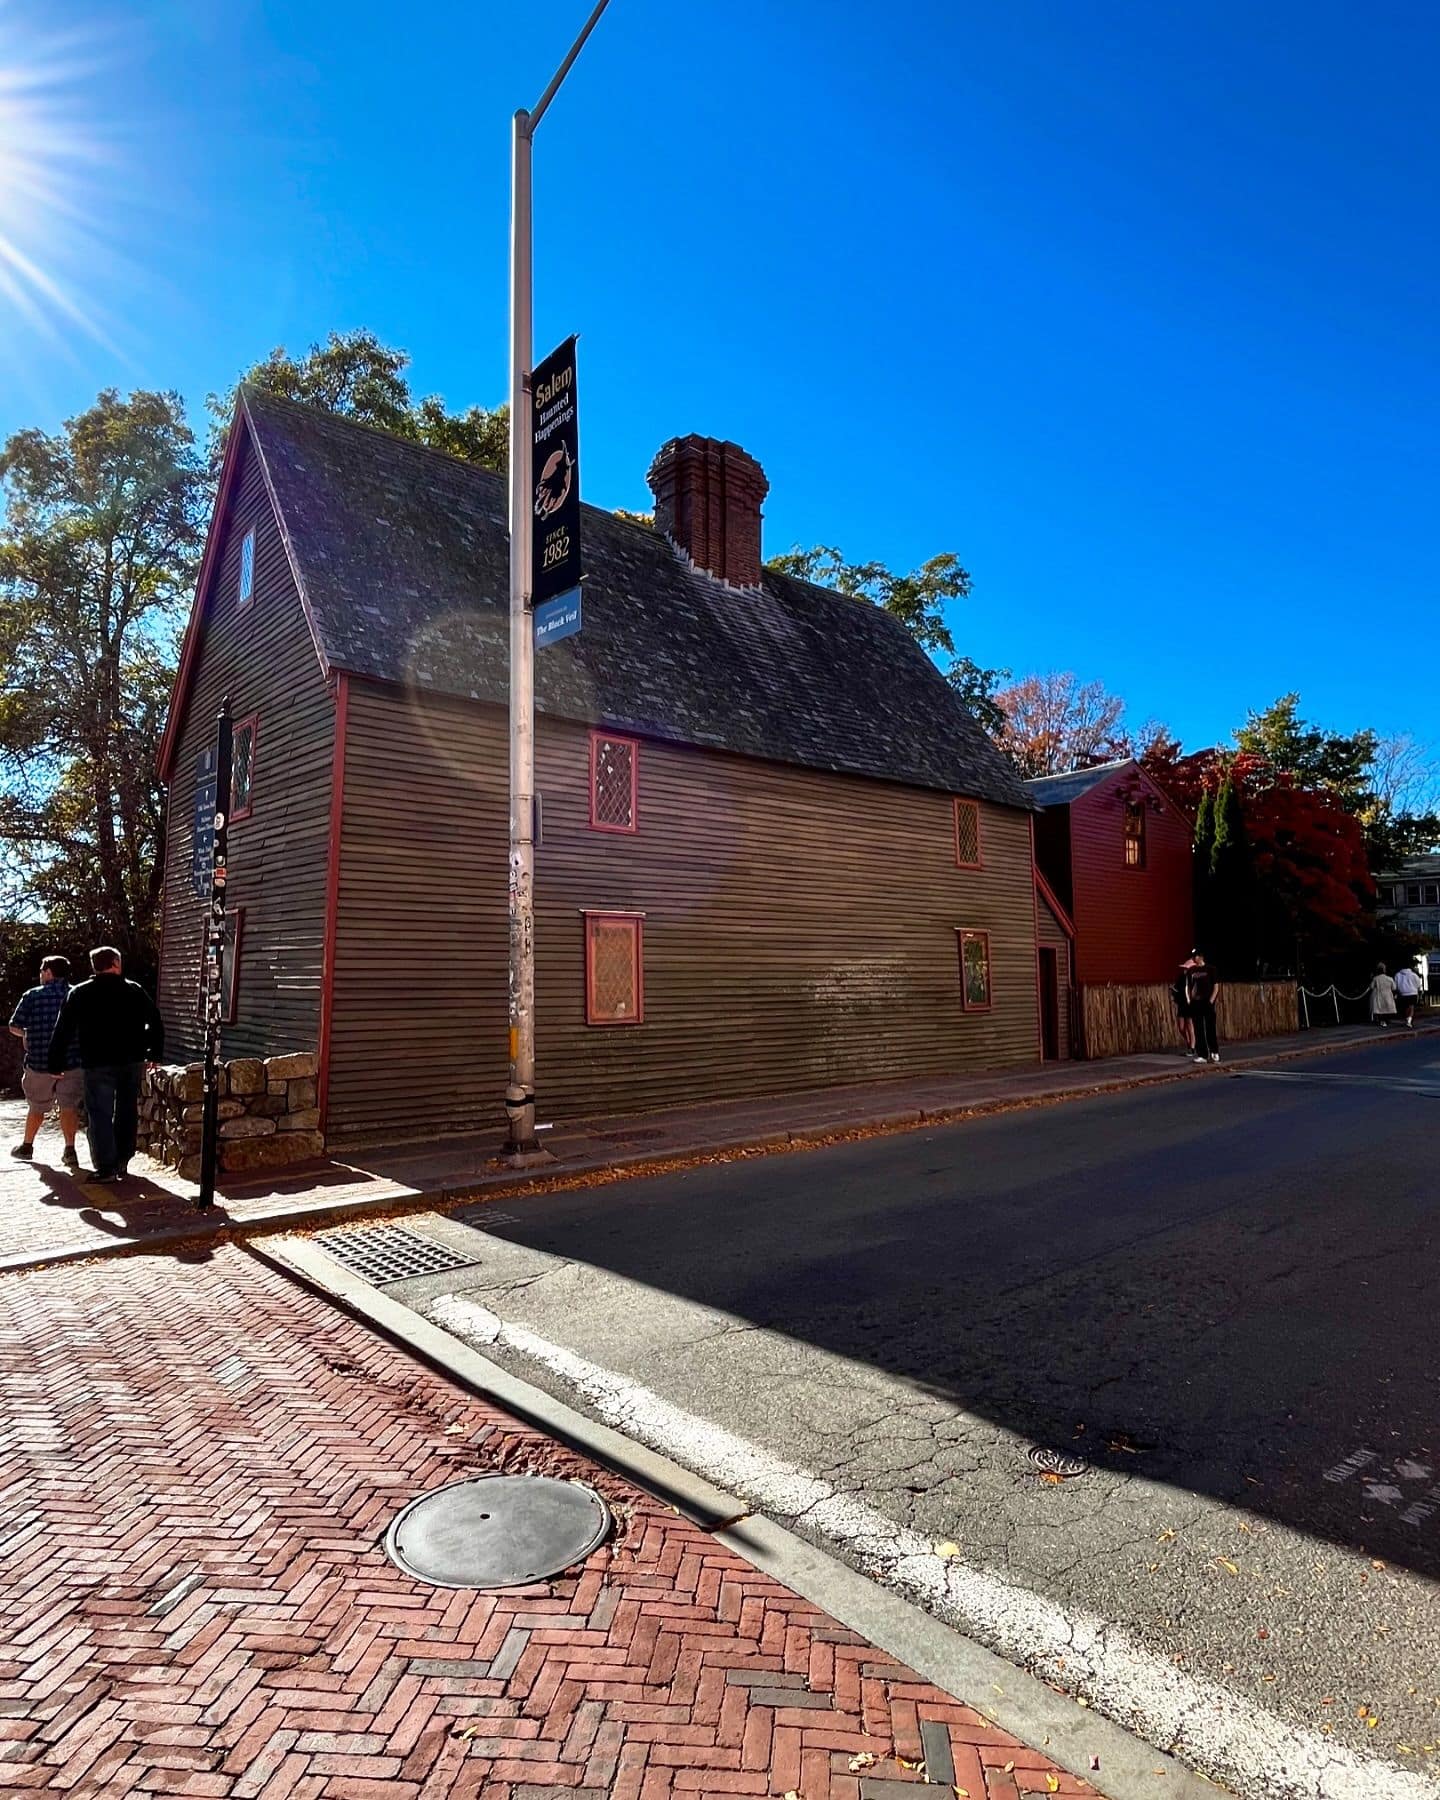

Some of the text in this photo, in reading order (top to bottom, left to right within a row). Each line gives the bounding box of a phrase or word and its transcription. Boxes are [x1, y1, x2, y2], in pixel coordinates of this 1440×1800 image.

[536, 366, 572, 409] Salem
[535, 406, 574, 443] Happenings
[540, 392, 569, 426] Haunted
[543, 536, 569, 567] 1982
